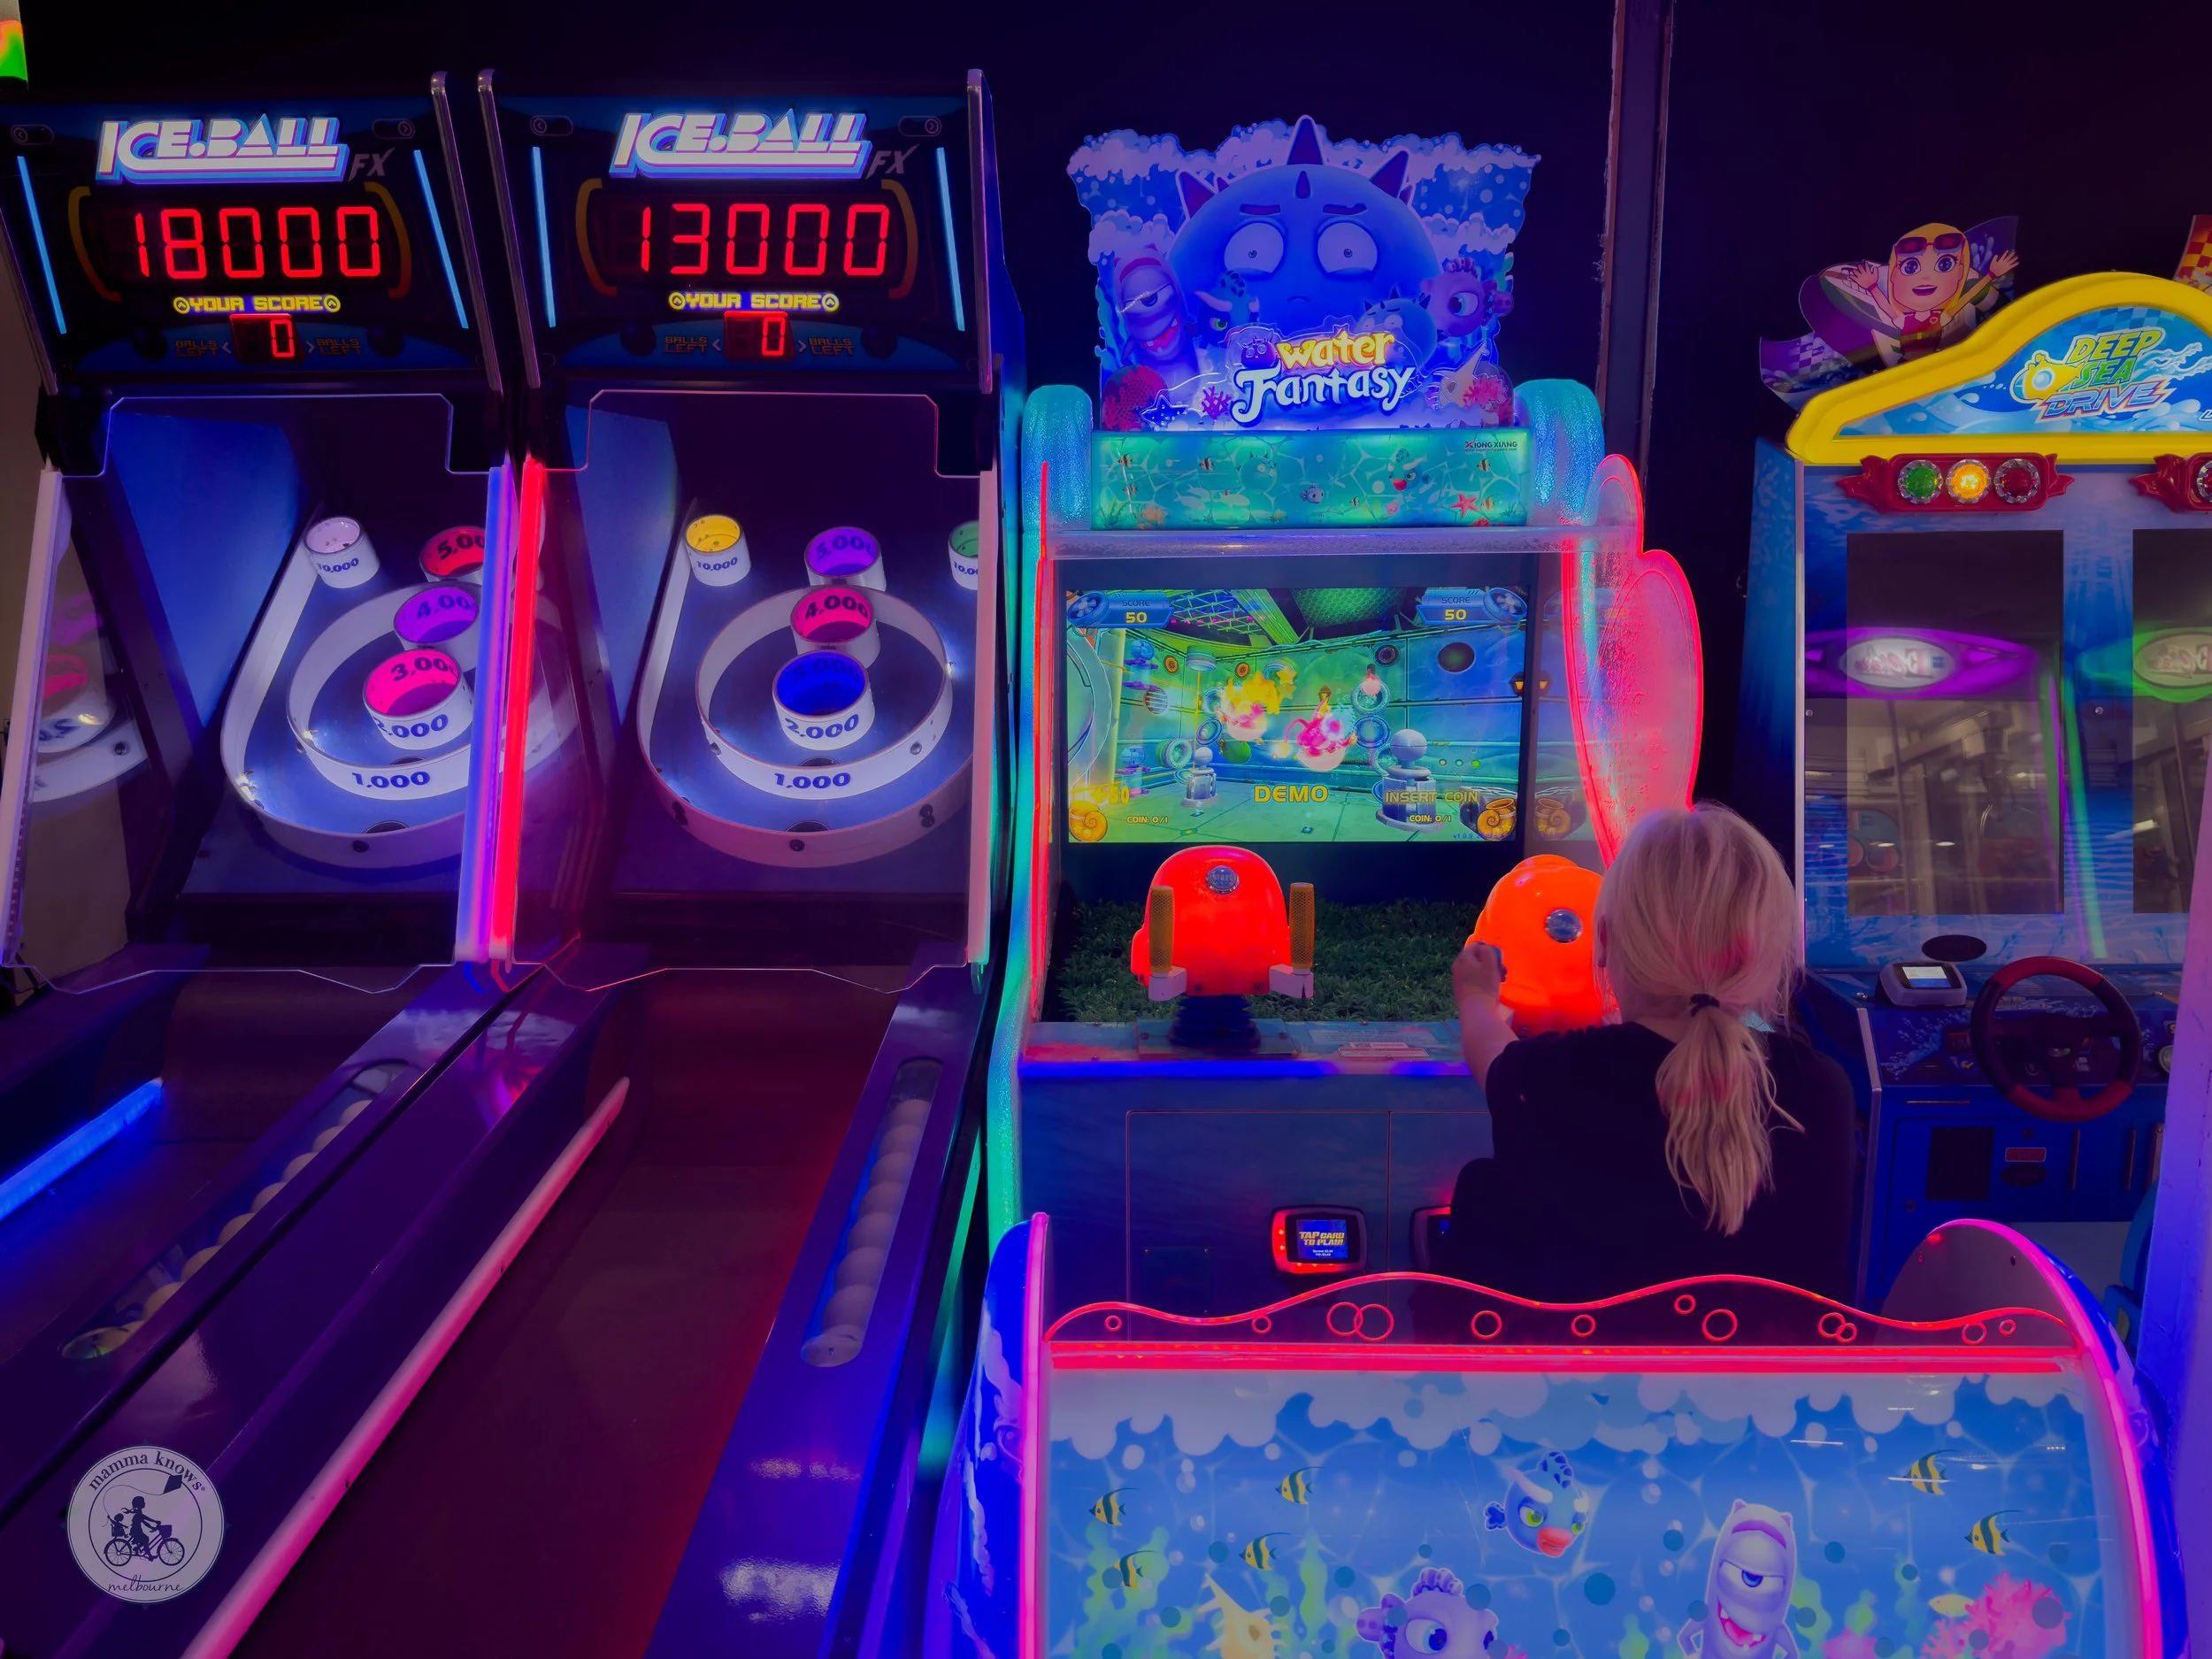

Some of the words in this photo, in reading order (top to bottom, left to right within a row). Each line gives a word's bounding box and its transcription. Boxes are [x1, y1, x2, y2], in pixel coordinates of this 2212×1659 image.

[348, 148, 394, 181] FX
[866, 144, 919, 179] FX
[134, 206, 380, 279] 18000
[641, 204, 889, 276] 13000
[189, 297, 244, 311] YOUR
[253, 296, 323, 311] SCORE
[685, 293, 741, 309] YOUR
[750, 294, 822, 309] SCORE
[177, 348, 218, 357] LEFT
[270, 319, 295, 357] 0
[319, 346, 362, 355] LEFT
[665, 343, 708, 353] LEFT
[762, 317, 786, 356] 0
[1276, 329, 1395, 372] water
[2065, 329, 2163, 365] DEEP
[2071, 357, 2138, 388] SEA
[1231, 364, 1416, 425] Fantasy
[2040, 380, 2166, 419] DRIVE
[1125, 611, 1148, 624] 50
[1444, 609, 1467, 621] 50
[1254, 785, 1329, 803] DEMO
[1385, 790, 1436, 803] INSERT
[1443, 790, 1479, 803] COIN
